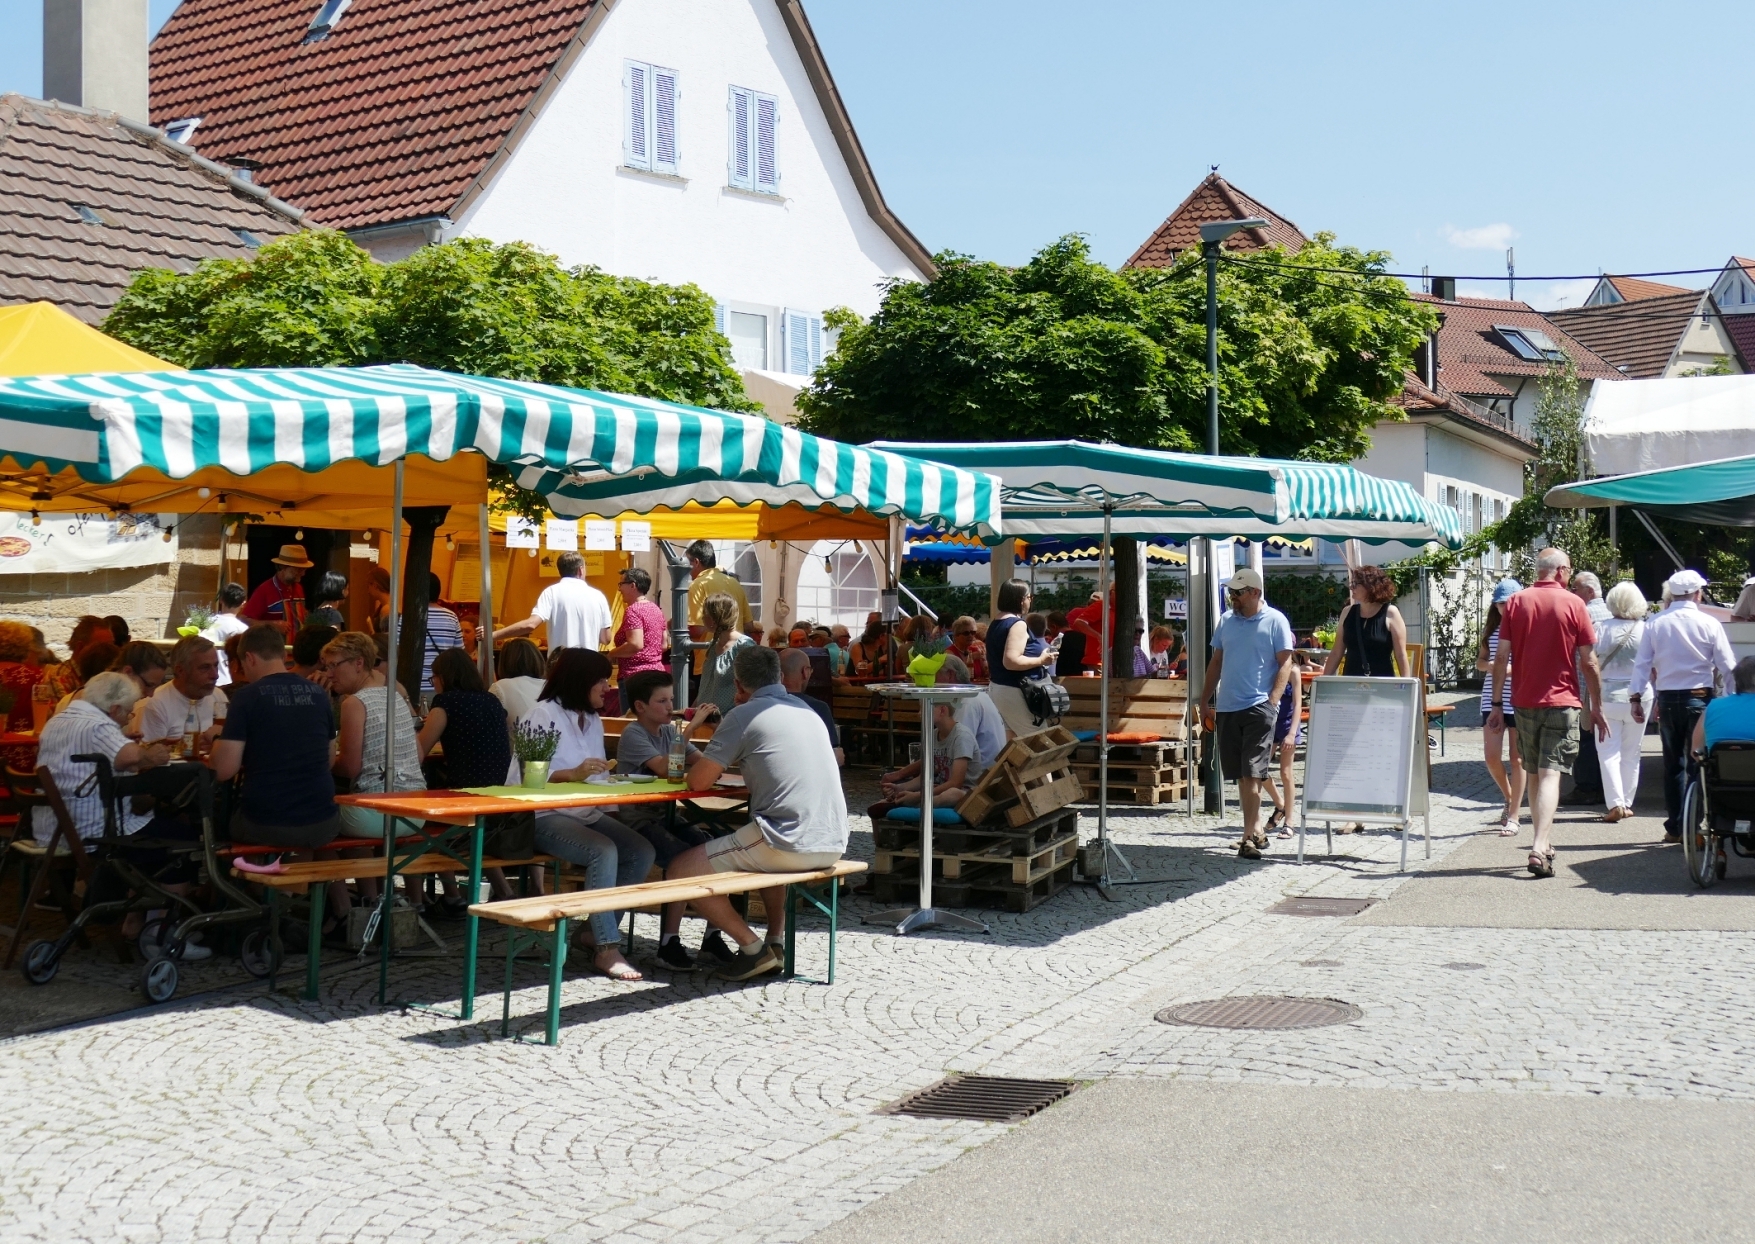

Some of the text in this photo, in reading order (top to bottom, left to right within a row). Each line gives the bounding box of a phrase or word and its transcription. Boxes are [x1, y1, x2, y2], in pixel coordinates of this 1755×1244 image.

[1169, 603, 1186, 611] WC
[259, 684, 322, 695] DENIM BRAND
